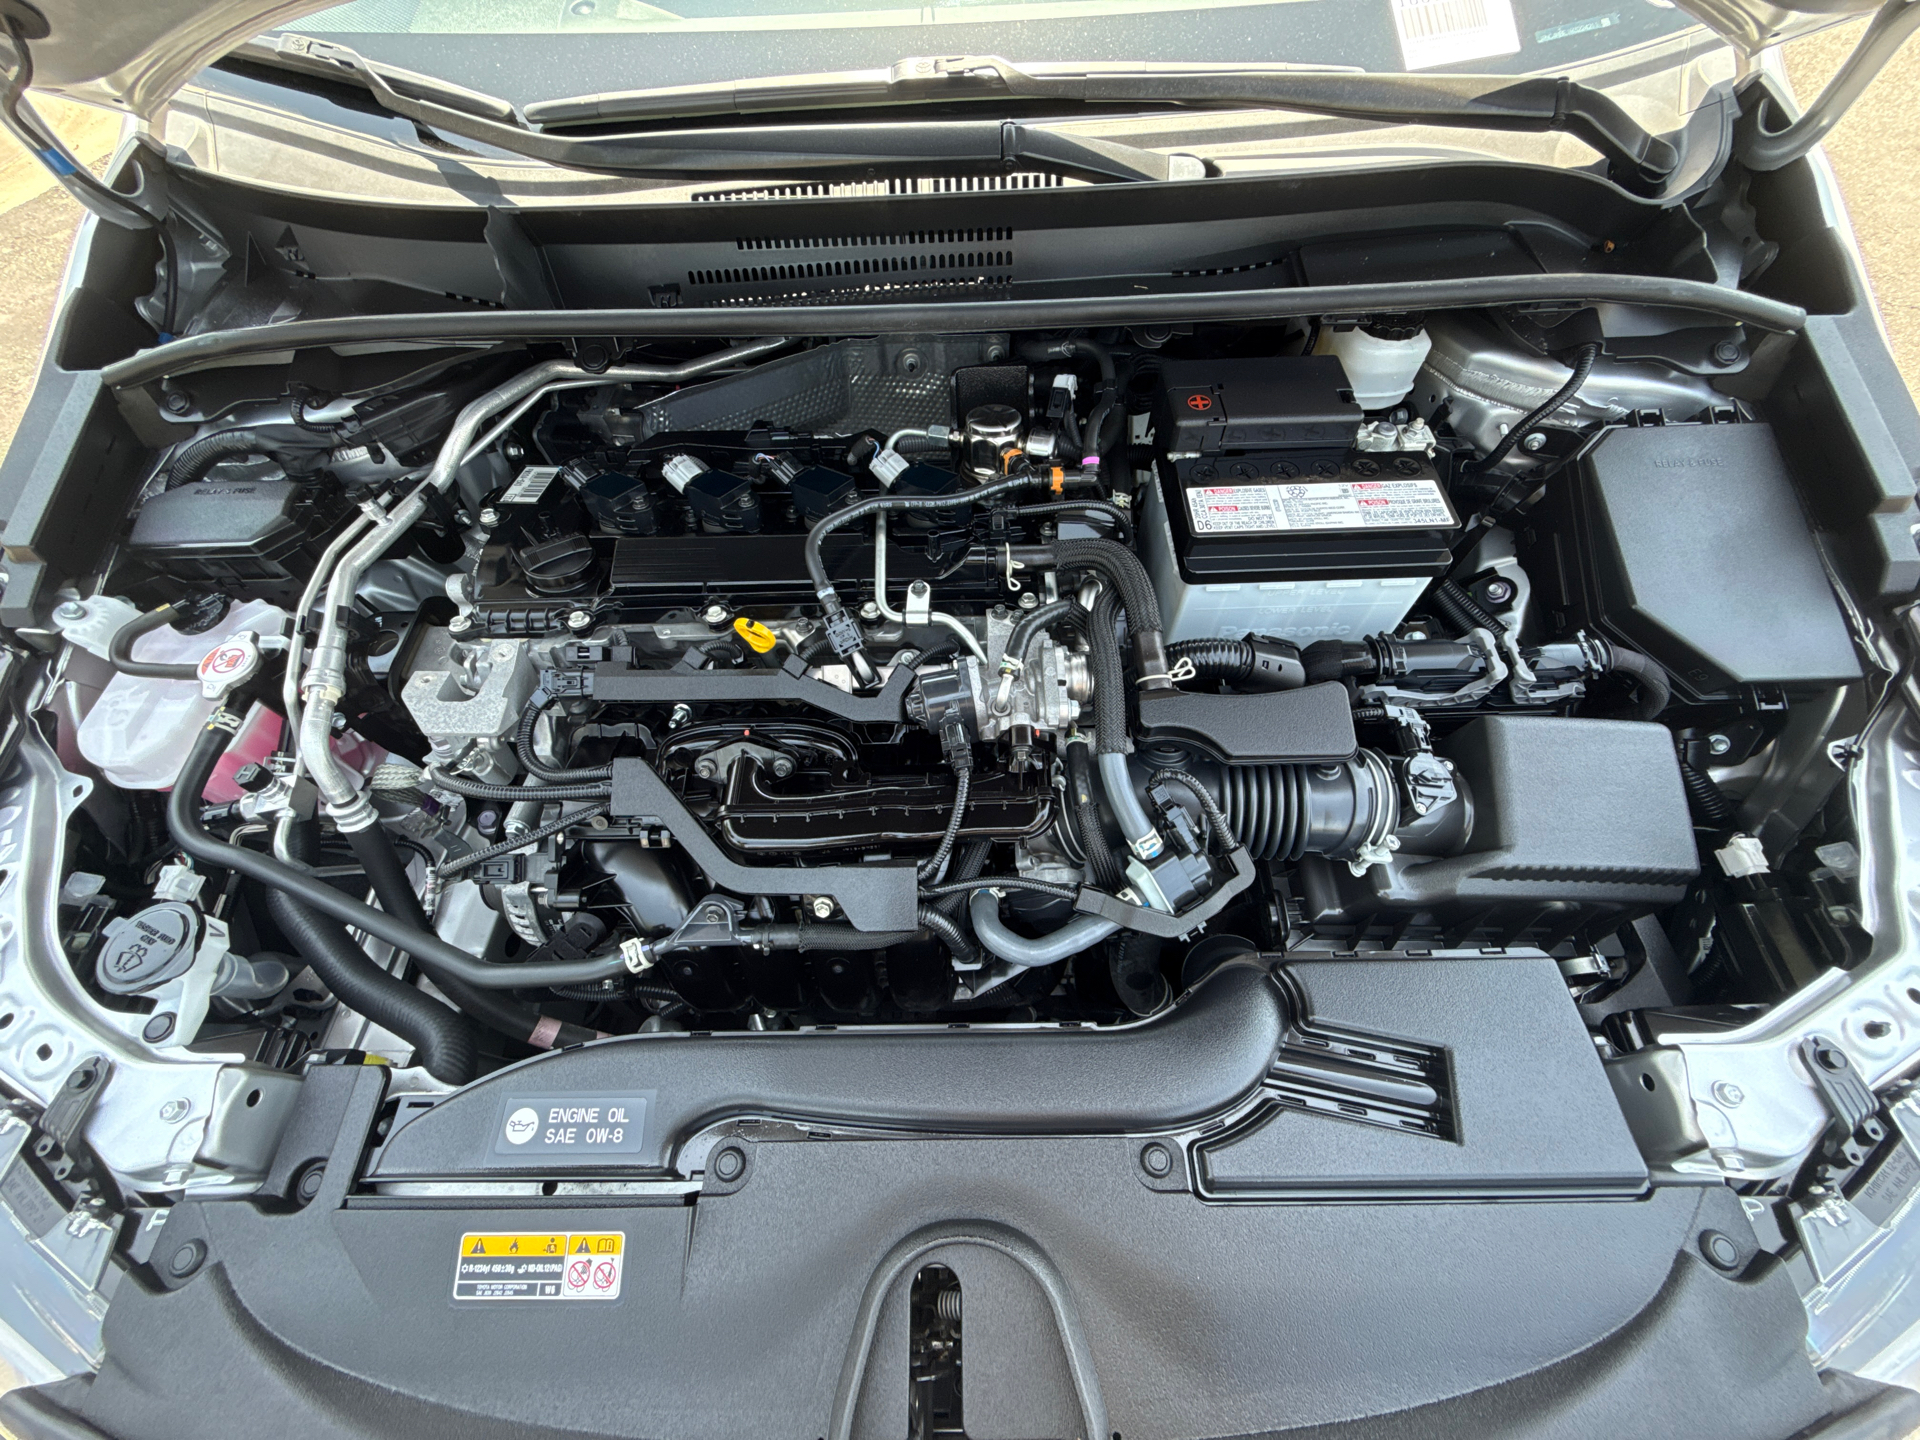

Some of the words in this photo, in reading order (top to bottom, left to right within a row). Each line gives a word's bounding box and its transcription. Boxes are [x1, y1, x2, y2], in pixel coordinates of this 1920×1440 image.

[1698, 458, 1724, 467] FUSE
[1197, 520, 1212, 530] D6
[1268, 589, 1305, 597] UPPER
[1258, 607, 1296, 615] LOWER
[1218, 623, 1351, 639] Panasonic
[548, 1108, 600, 1123] ENGINE
[608, 1108, 630, 1123] OIL
[544, 1128, 576, 1143] SAE
[586, 1128, 623, 1143] 0W-8
